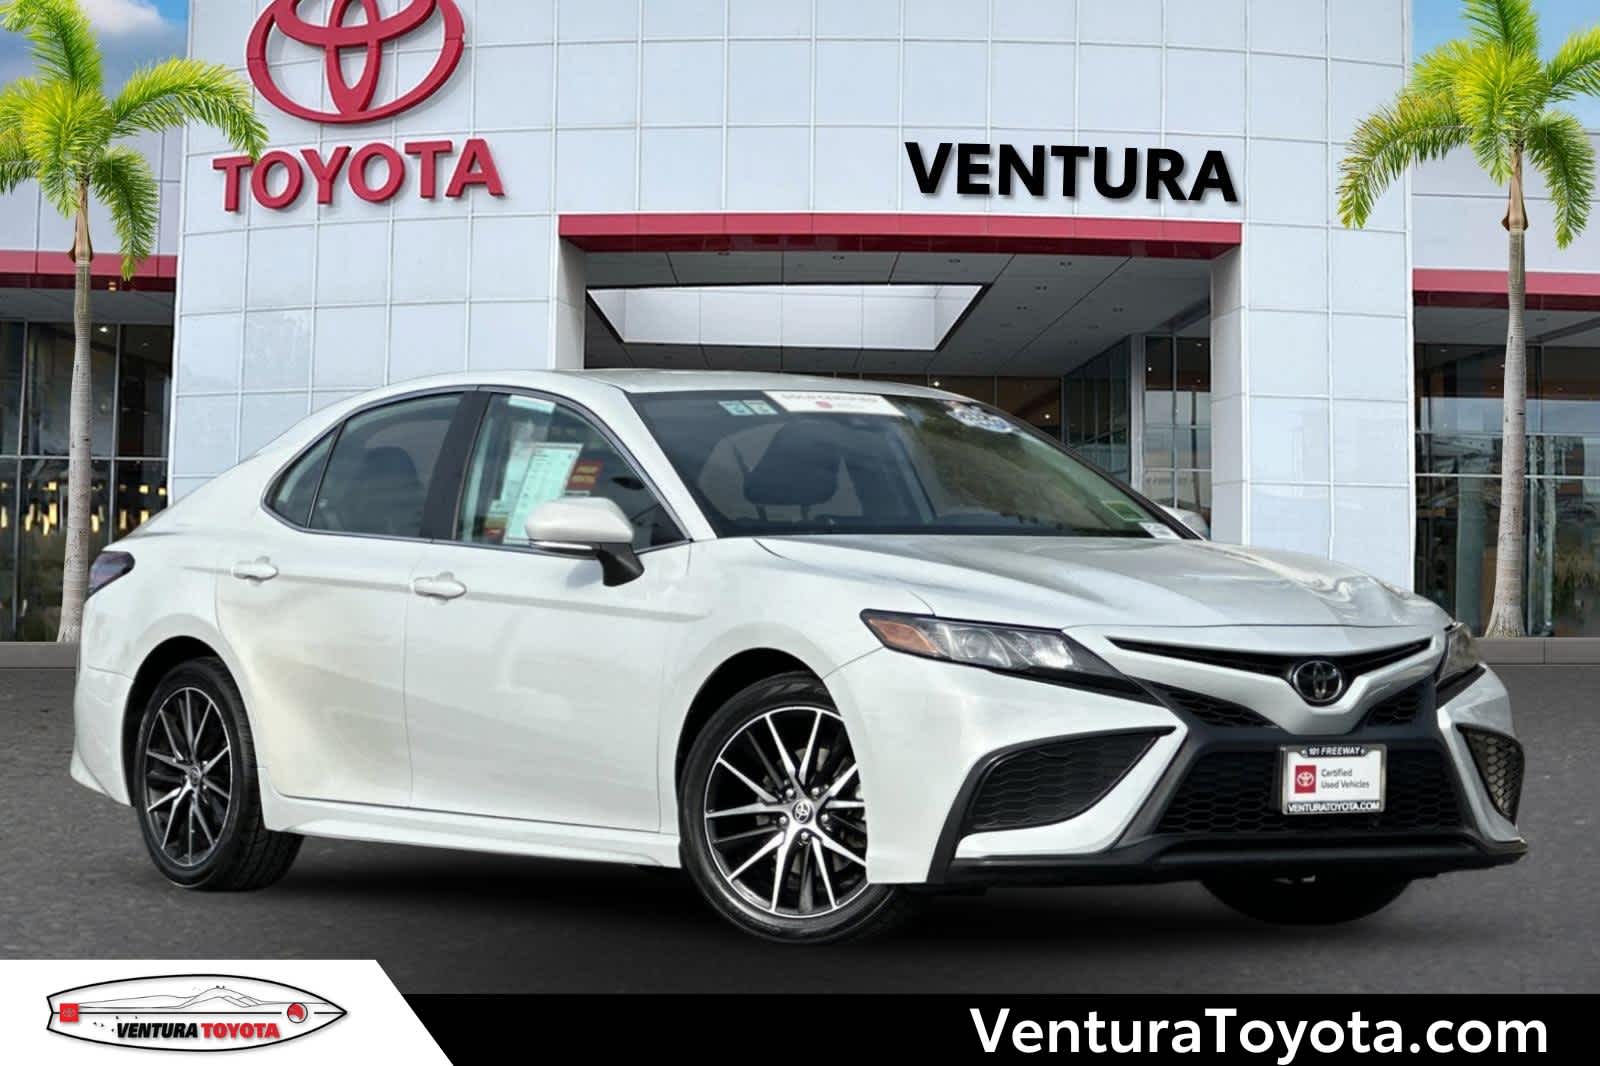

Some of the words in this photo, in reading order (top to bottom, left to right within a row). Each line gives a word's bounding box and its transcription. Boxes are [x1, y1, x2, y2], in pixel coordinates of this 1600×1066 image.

[213, 139, 504, 211] TOYOTA
[904, 141, 1239, 203] VENTURA
[1321, 746, 1360, 756] FREEWAY
[1321, 781, 1339, 789] Used
[1341, 780, 1370, 788] Vehicles
[1288, 801, 1380, 812] VENTURATOYOTA.COM
